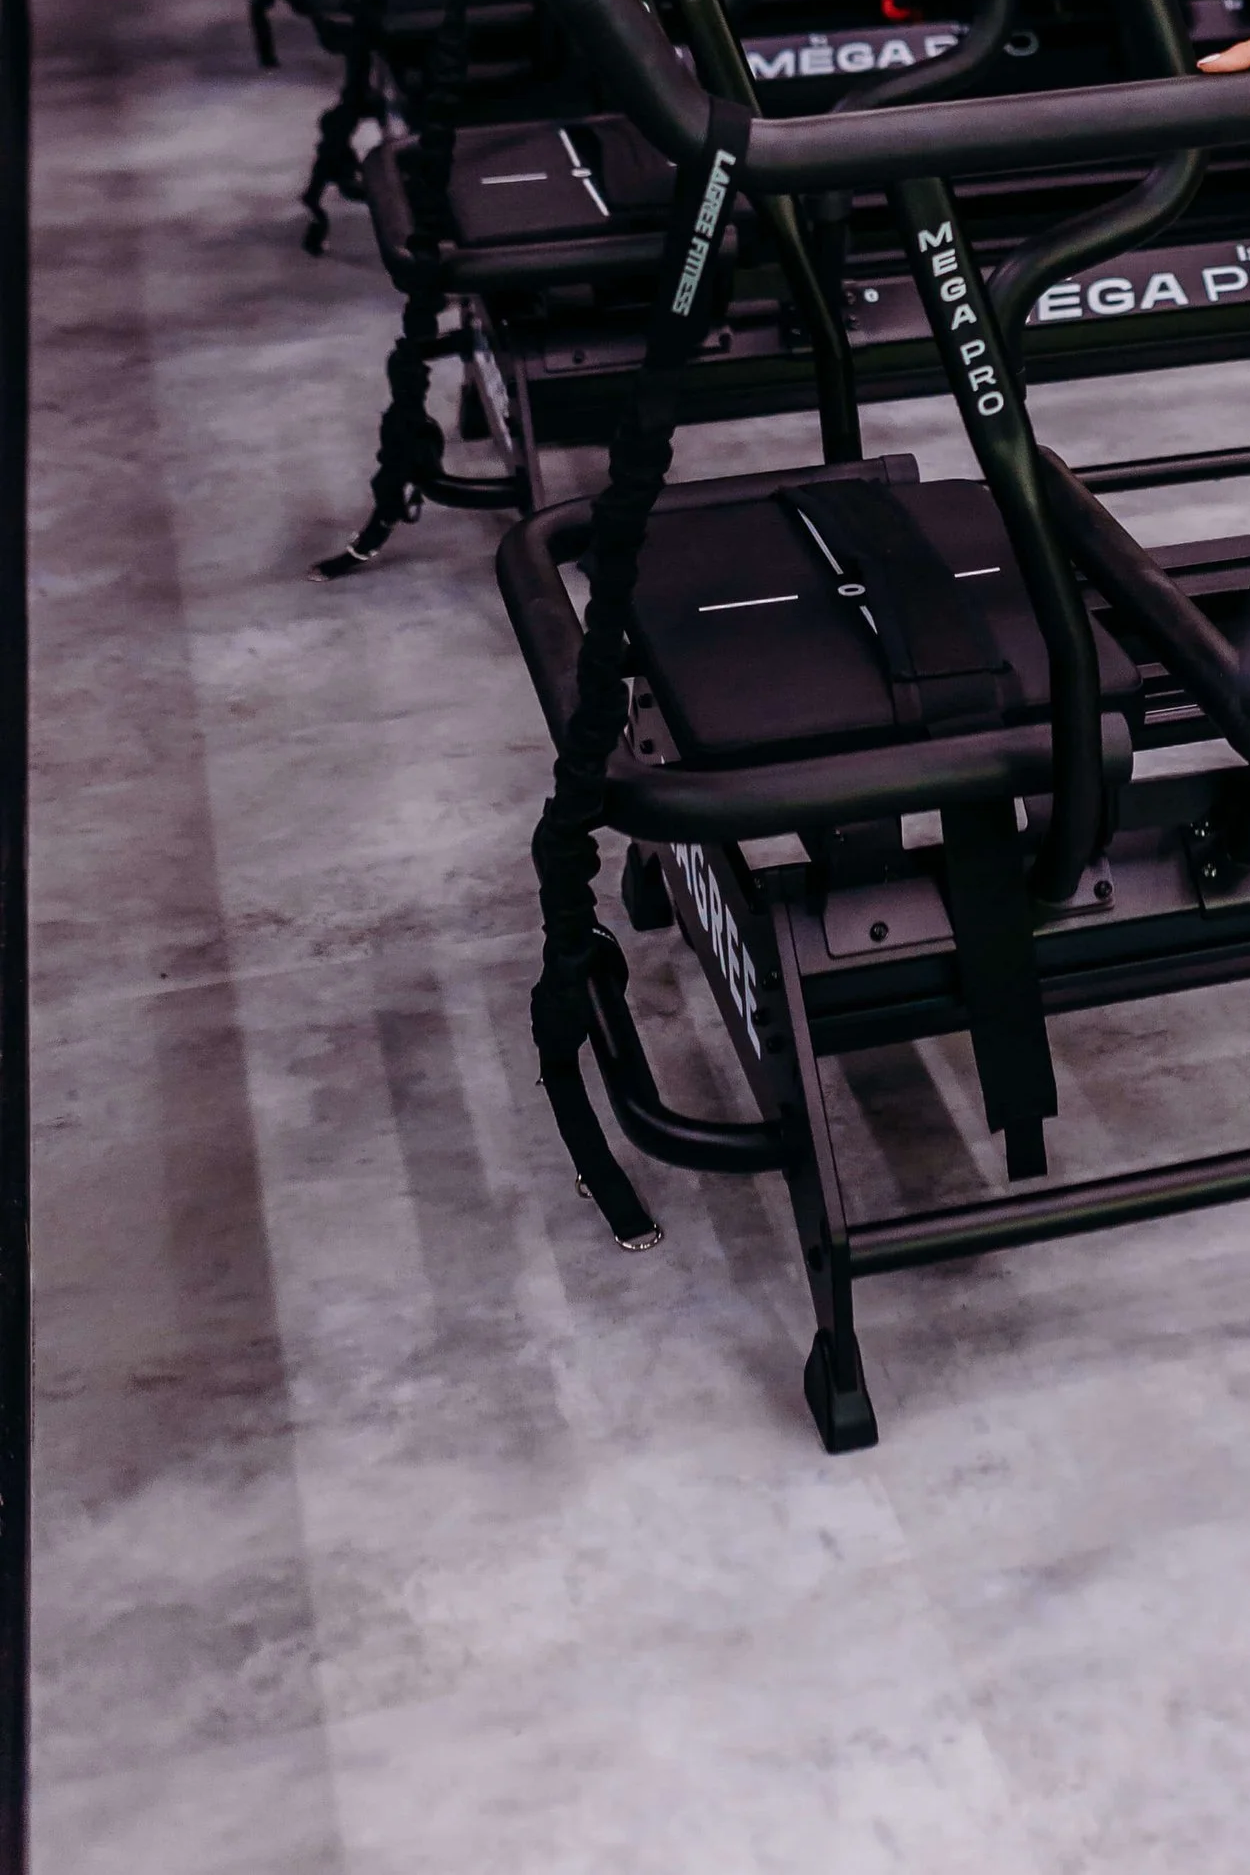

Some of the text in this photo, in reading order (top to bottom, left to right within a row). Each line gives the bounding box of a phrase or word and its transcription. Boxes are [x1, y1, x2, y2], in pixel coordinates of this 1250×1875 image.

[749, 39, 916, 78] MEGA
[917, 221, 1005, 417] MEGA PRO
[1026, 272, 1189, 323] EGA
